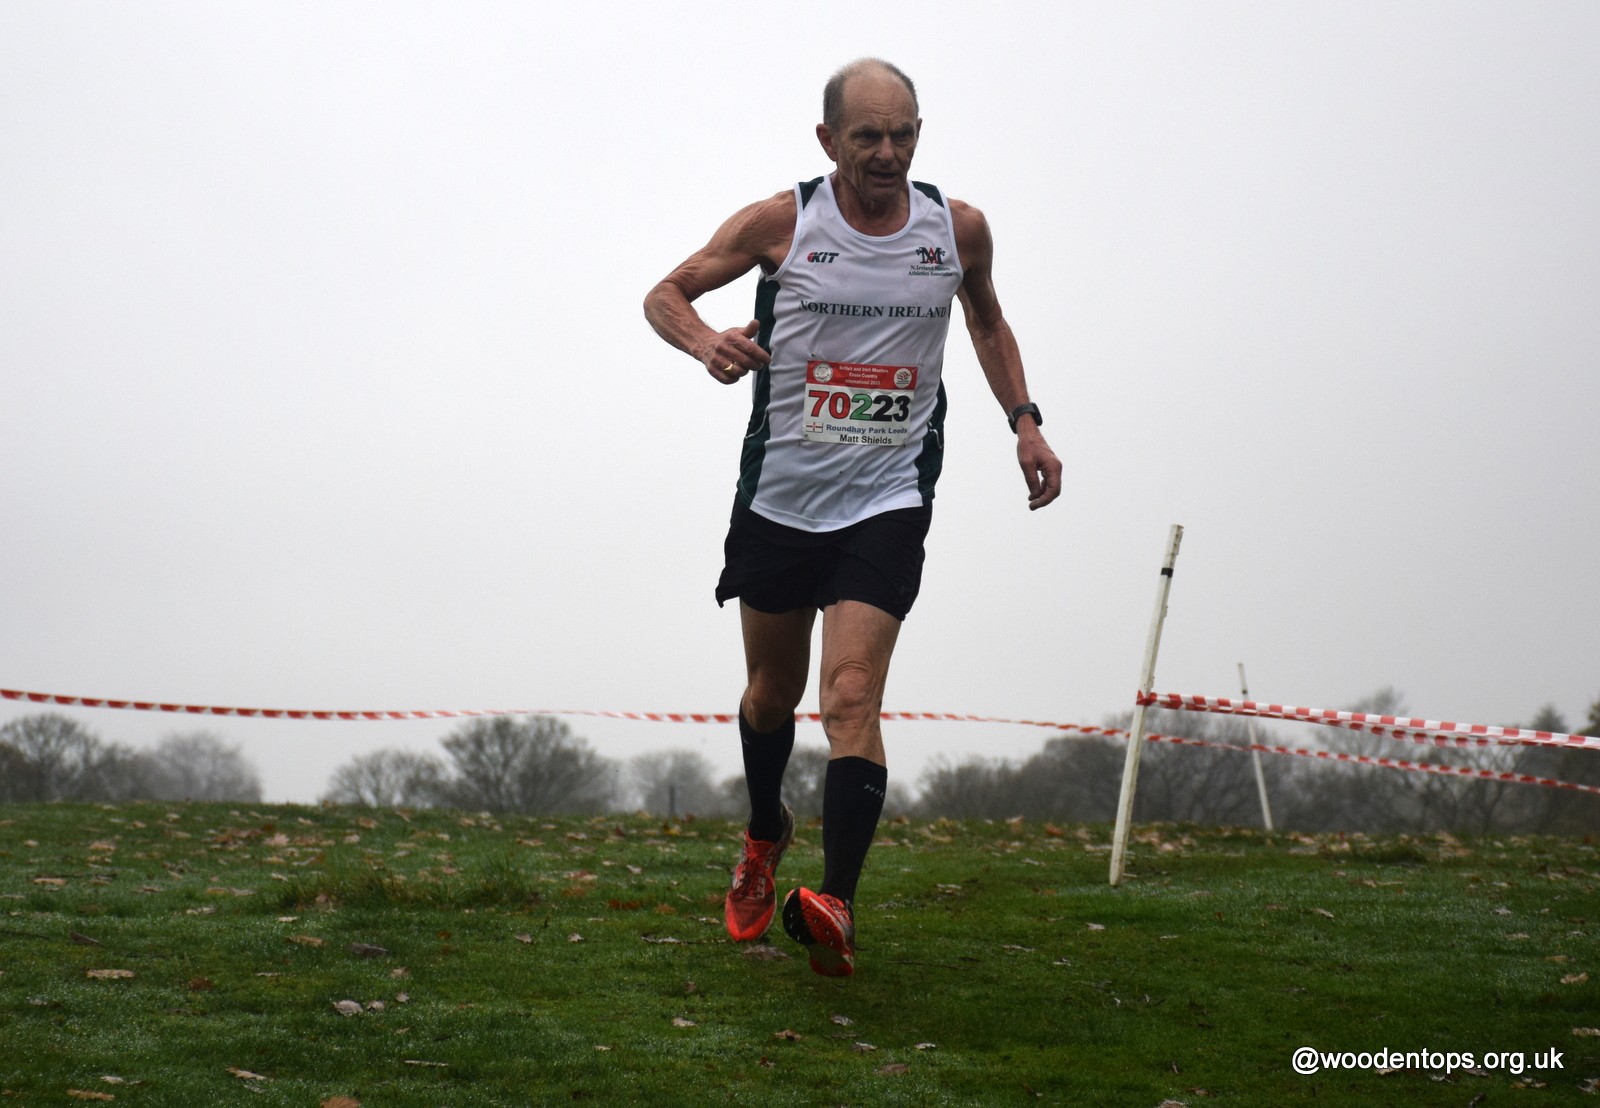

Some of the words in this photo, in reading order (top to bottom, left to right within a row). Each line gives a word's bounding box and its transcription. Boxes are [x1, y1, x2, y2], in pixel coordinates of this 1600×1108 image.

[799, 300, 884, 318] NORTHERN
[887, 304, 947, 318] IRELAND
[808, 389, 911, 423] 70223
[826, 424, 867, 435] Roundhay
[839, 434, 859, 443] Matt
[861, 436, 893, 445] Shields
